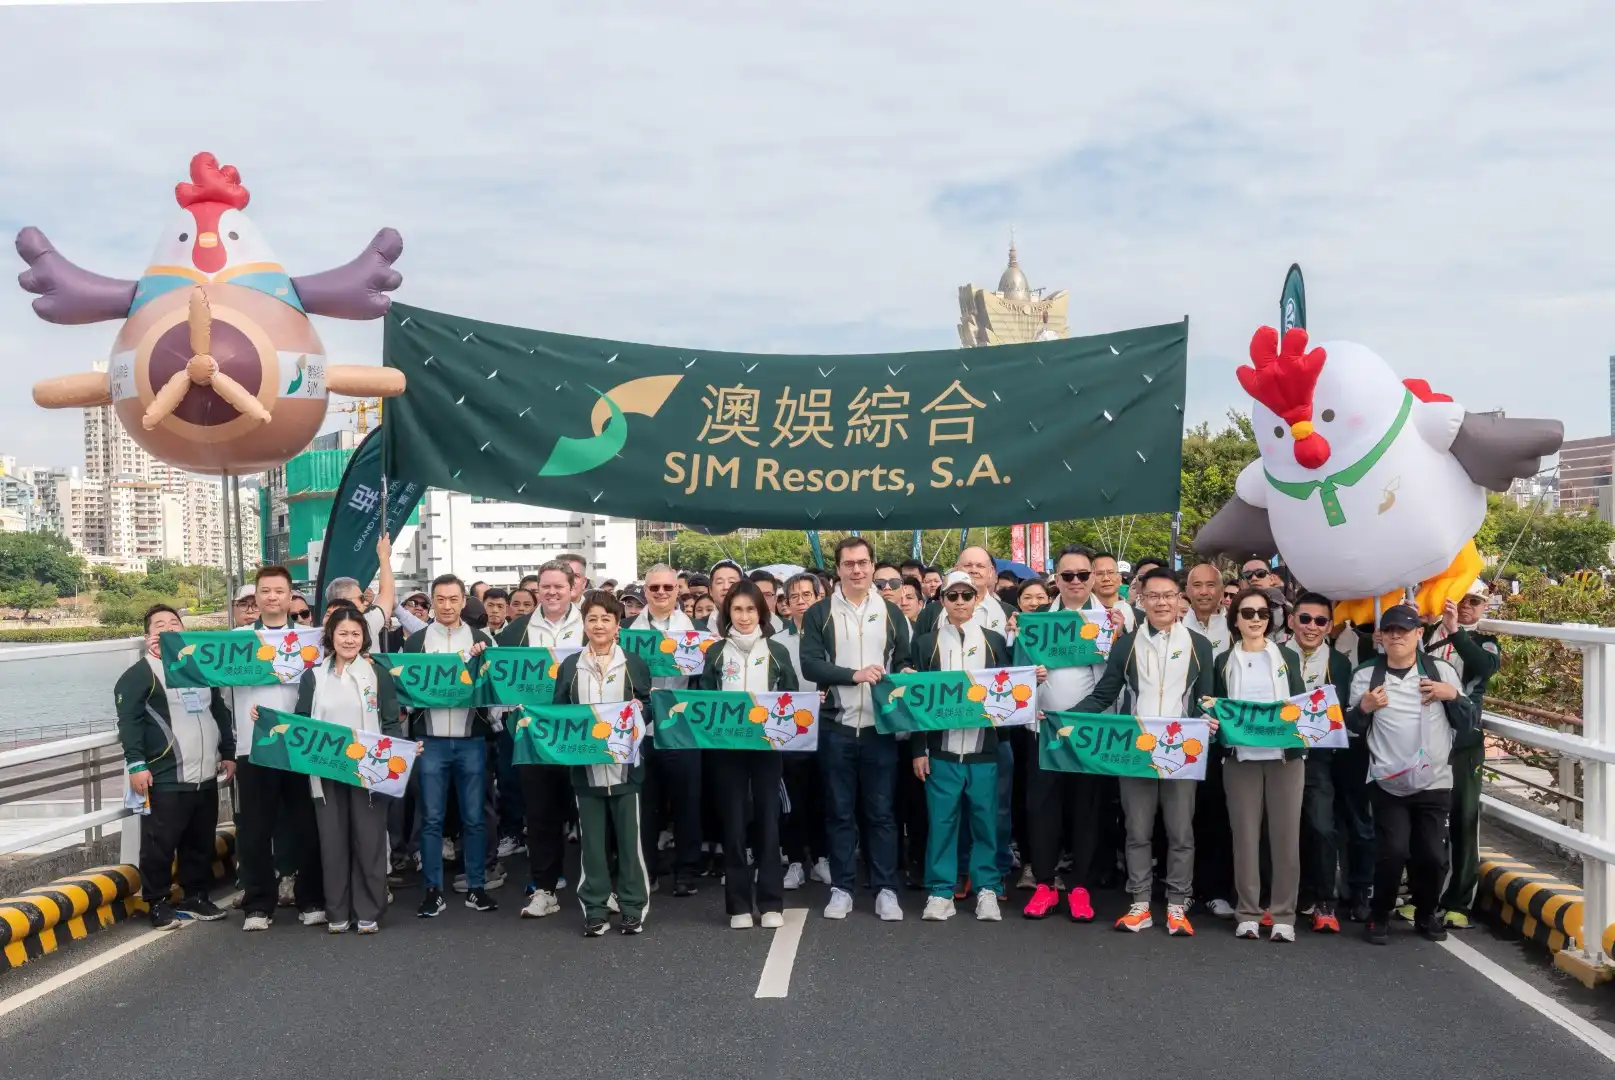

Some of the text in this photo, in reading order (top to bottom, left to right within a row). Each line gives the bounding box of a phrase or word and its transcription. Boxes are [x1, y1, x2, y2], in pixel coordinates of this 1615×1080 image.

[696, 379, 988, 449] 澳娛綜合
[663, 451, 1012, 497] SJM Resorts, S.A.
[353, 521, 375, 552] GRAND
[1024, 620, 1077, 652] SJM
[199, 641, 254, 671] SJM
[405, 664, 458, 691] SJM
[493, 658, 546, 687] SJM
[909, 681, 964, 712] SJM
[690, 700, 746, 731] SJM
[1220, 700, 1277, 728] SJM
[288, 725, 347, 757] SJM
[533, 718, 589, 747] SJM
[1075, 725, 1134, 757] SJM
